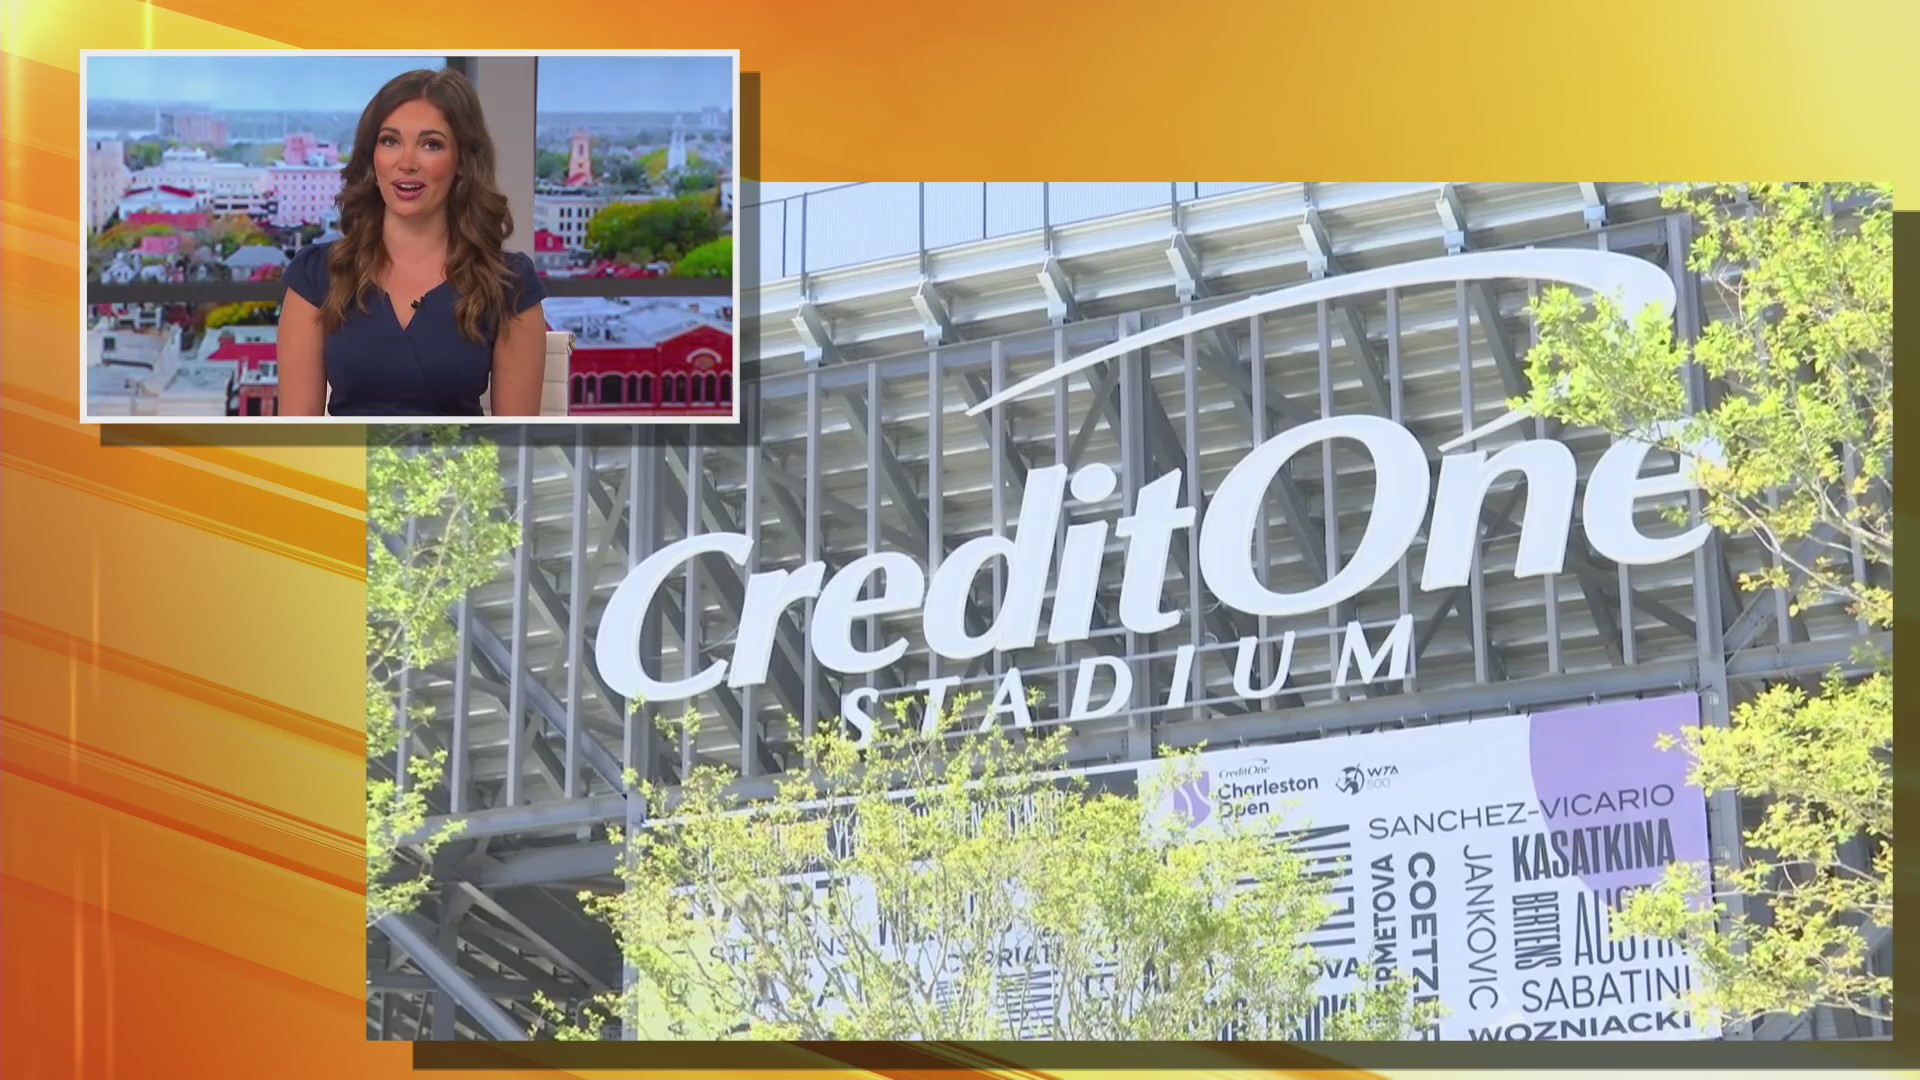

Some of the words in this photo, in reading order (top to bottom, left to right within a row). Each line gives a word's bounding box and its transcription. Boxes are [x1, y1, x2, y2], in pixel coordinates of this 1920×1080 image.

[842, 614, 1414, 749] STADIUM
[1218, 776, 1319, 800] Charleston
[1367, 765, 1399, 777] WTA
[1219, 801, 1270, 819] Open
[1368, 783, 1675, 840] SANCHEZ-VICARIO
[1511, 818, 1676, 883] KASATKINA
[1463, 844, 1499, 1011] JANKOVIC
[1512, 891, 1561, 970] BERTENS
[1521, 965, 1691, 1014] SABATINI
[1468, 1010, 1692, 1041] WOZNIACKI
